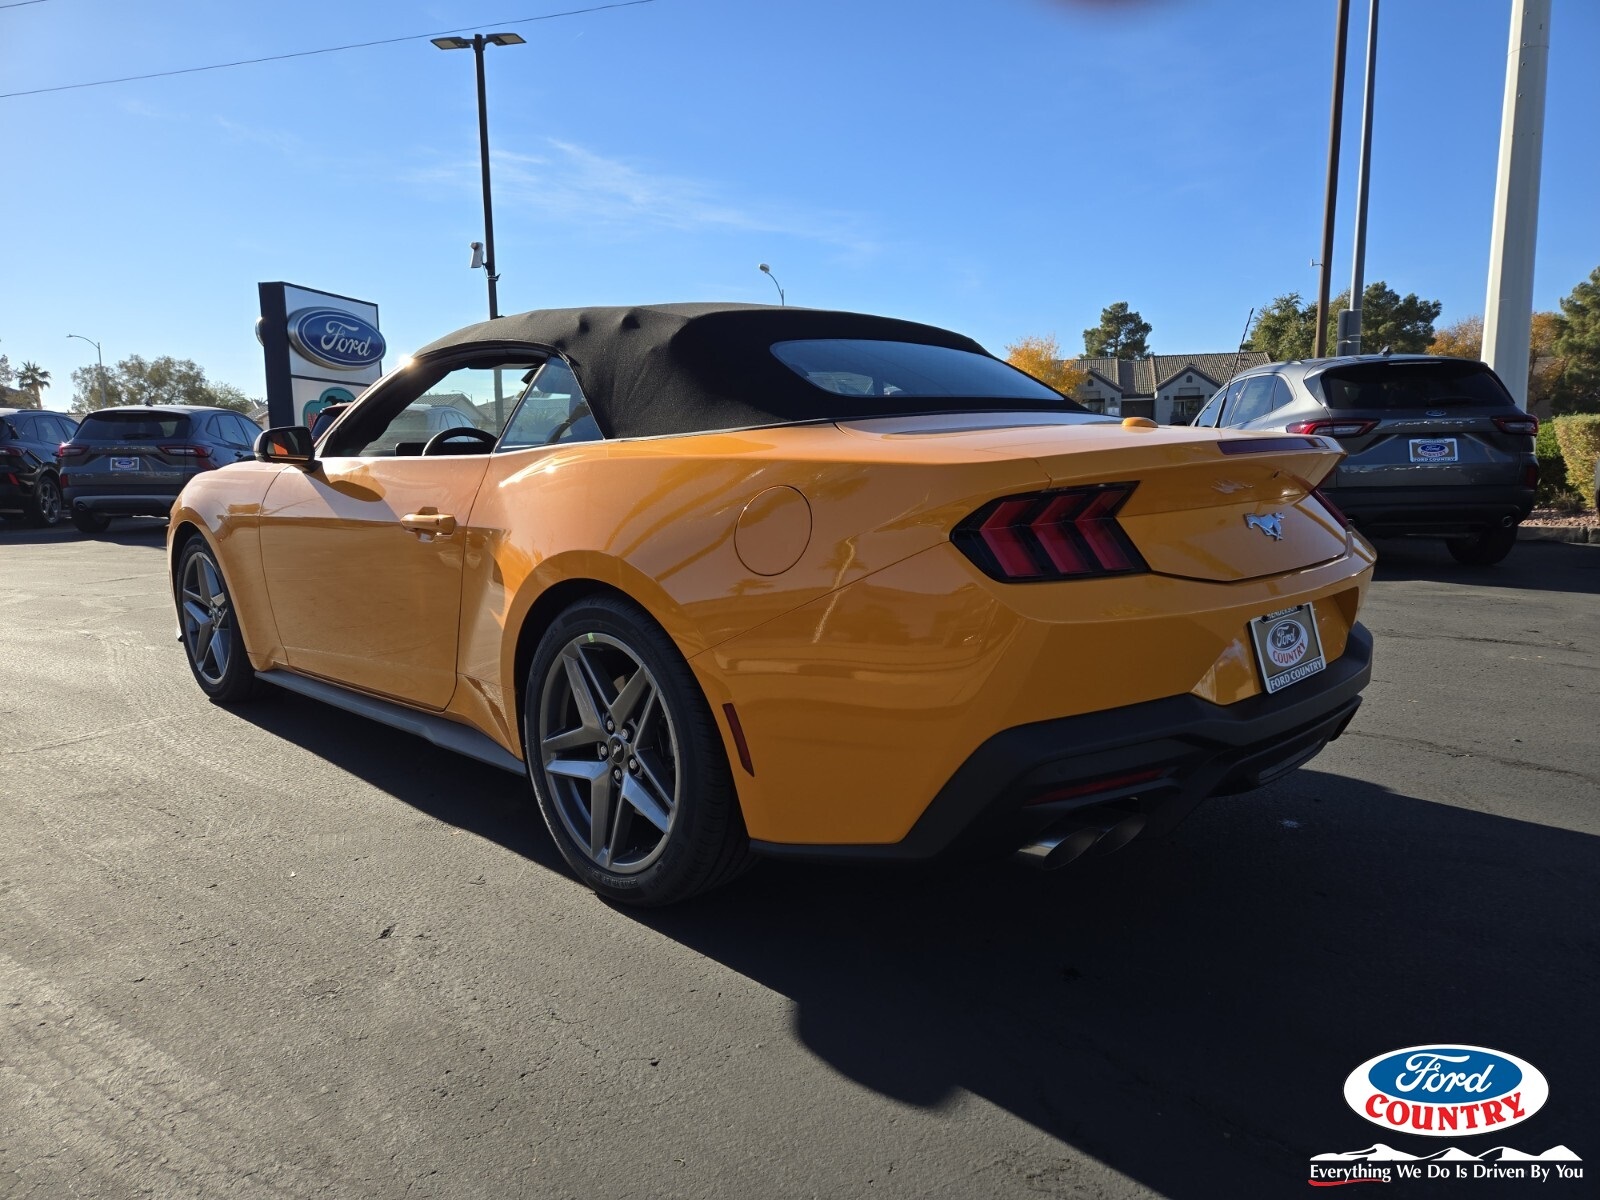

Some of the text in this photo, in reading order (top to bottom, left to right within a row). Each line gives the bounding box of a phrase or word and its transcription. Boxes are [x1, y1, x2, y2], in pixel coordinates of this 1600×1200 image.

[321, 320, 371, 357] Ford
[1276, 625, 1297, 648] Ford
[1272, 641, 1306, 664] COUNTRY
[1270, 659, 1323, 690] FORD COUNTRY
